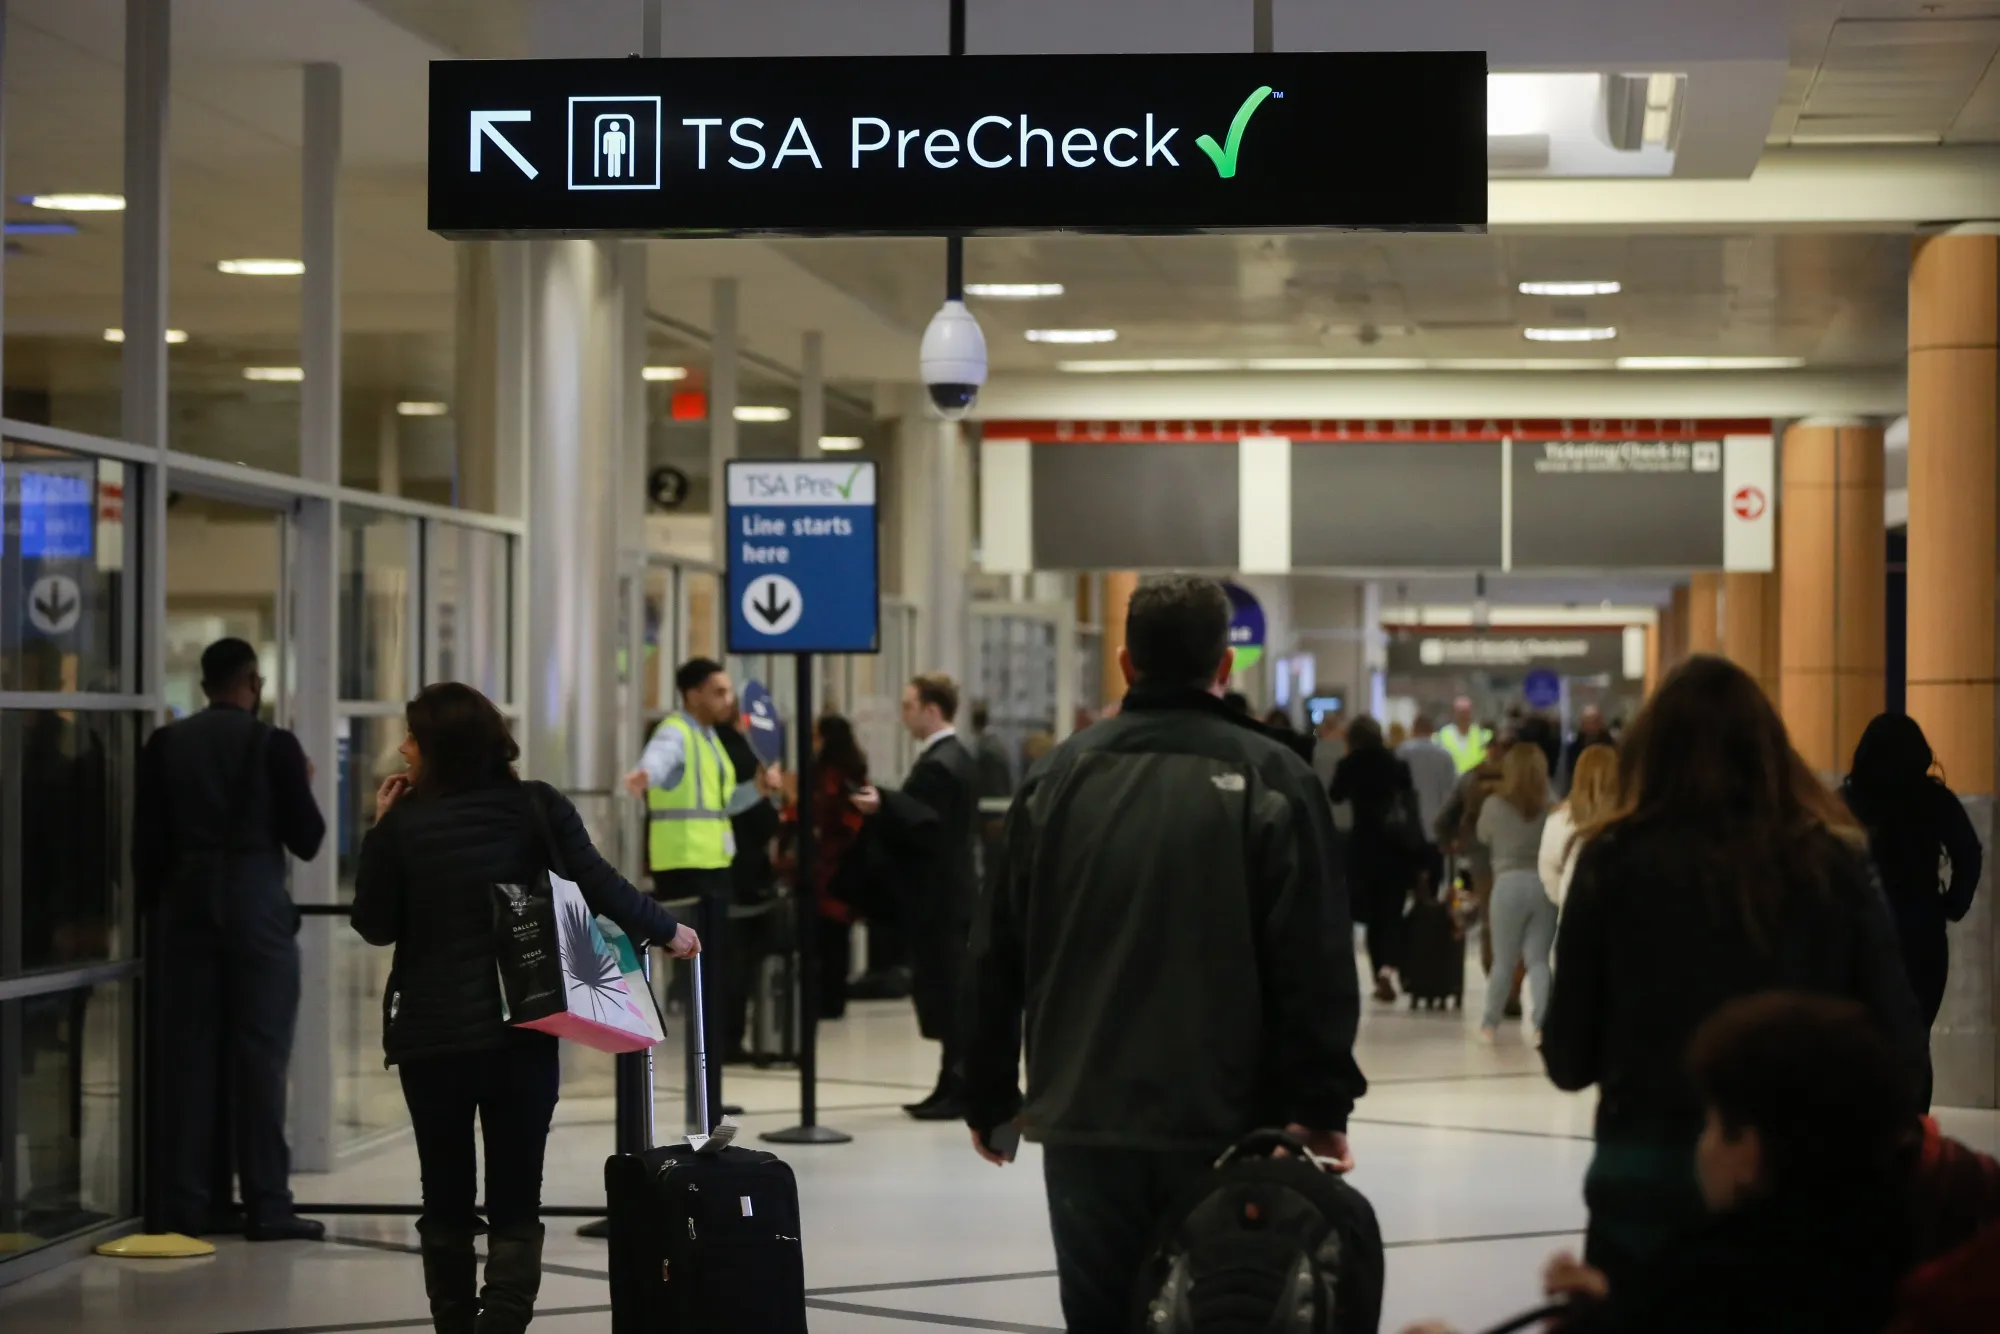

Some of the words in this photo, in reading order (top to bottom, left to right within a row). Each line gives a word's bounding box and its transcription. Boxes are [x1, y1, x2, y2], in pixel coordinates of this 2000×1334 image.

[682, 117, 823, 170] TSA
[851, 112, 1180, 169] PreCheck
[1055, 418, 1277, 440] DOMESTIC
[1310, 418, 1524, 439] TERMINAL
[1560, 417, 1698, 438] SOUTH
[658, 472, 677, 502] 2
[745, 473, 788, 497] TSA
[794, 473, 836, 497] Pre
[742, 514, 786, 536] Line
[792, 515, 852, 536] starts
[742, 542, 790, 564] here
[512, 920, 539, 933] DALLAS
[522, 948, 543, 960] VEGAS
